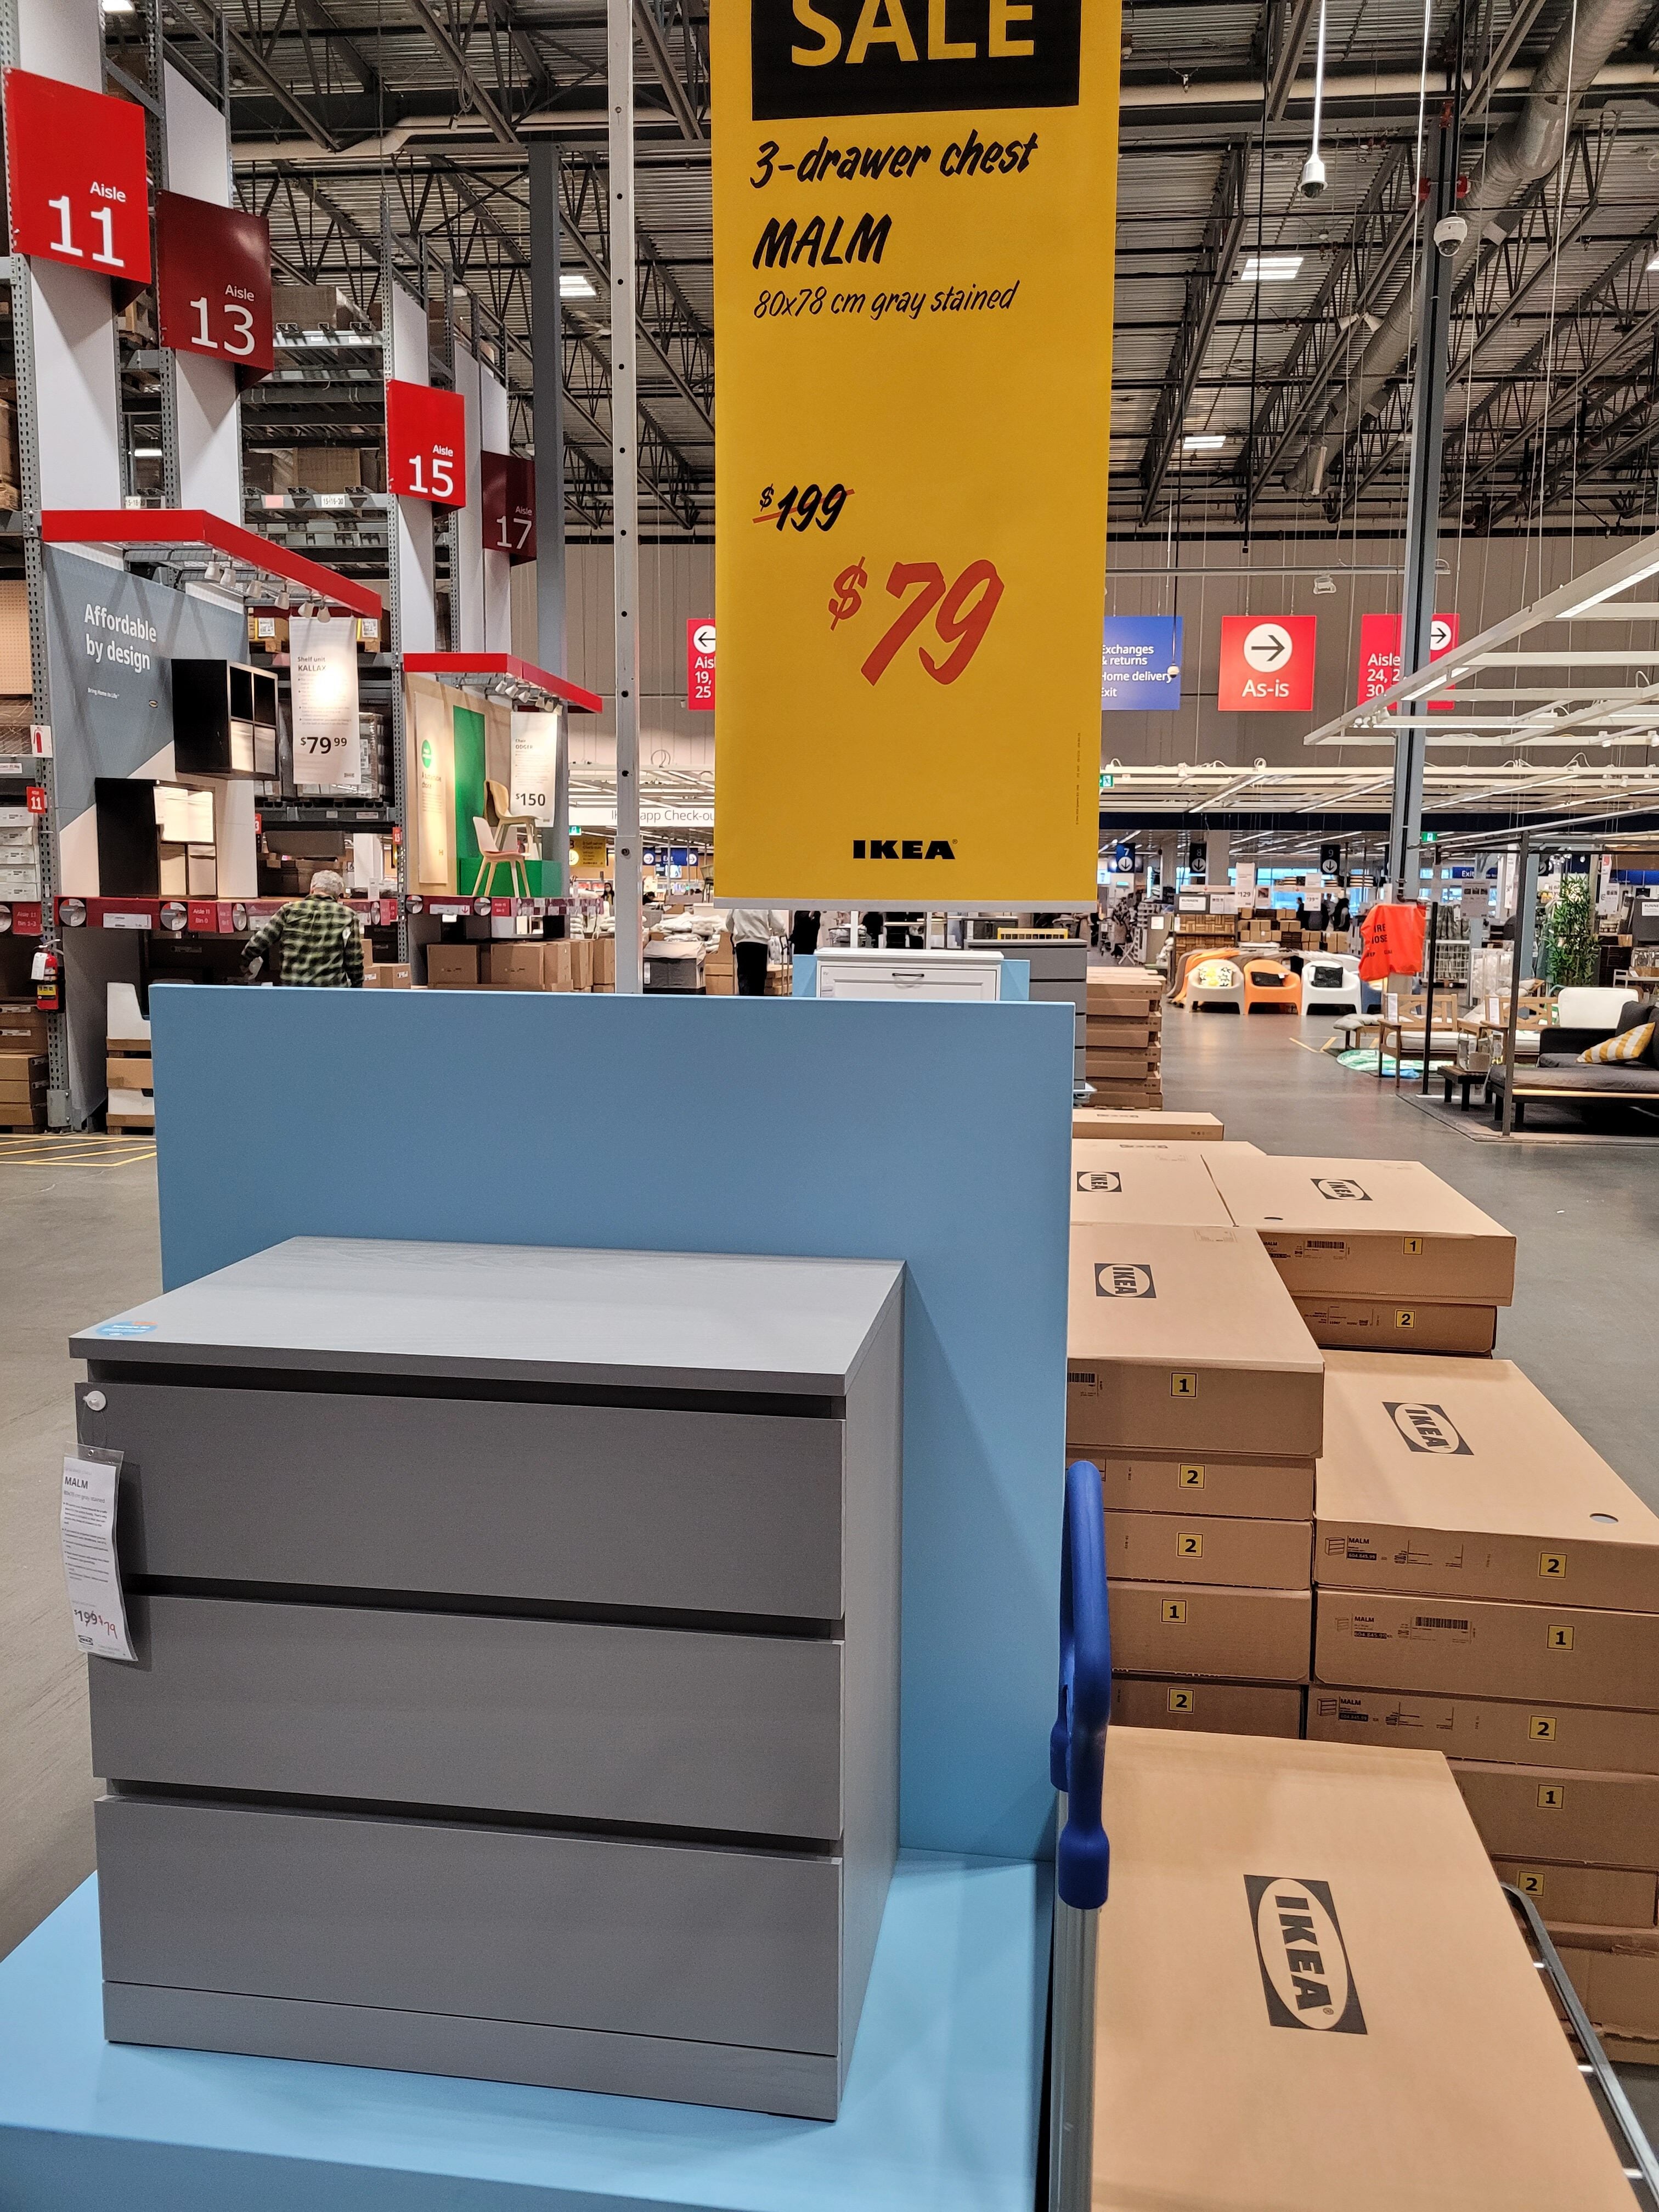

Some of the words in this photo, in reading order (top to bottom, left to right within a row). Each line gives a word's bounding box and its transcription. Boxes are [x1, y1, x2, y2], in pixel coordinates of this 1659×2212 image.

[792, 0, 1034, 66] SALE
[749, 136, 932, 189] 3-drawer
[939, 128, 1039, 177] chest
[90, 181, 126, 202] Aisle
[48, 196, 124, 267] 11
[752, 212, 893, 269] MALM
[225, 284, 255, 302] Aisle
[754, 286, 827, 318] 80x78
[831, 290, 866, 314] cm
[871, 290, 927, 320] gray
[930, 279, 1020, 313] stained
[190, 296, 255, 355] 13
[432, 444, 453, 456] Aisle
[408, 455, 454, 497] 15
[515, 505, 532, 516] Aisle
[496, 516, 532, 549] 17
[84, 603, 157, 643] Affordable
[828, 556, 1005, 686] $79
[86, 633, 103, 663] by
[107, 640, 150, 673] design
[1110, 656, 1148, 665] returns
[695, 670, 712, 685] 19,
[1132, 671, 1172, 683] delivery
[1367, 669, 1387, 684] 24,
[1392, 669, 1400, 682] 2
[695, 686, 712, 698] 25
[1242, 680, 1289, 698] As-is
[301, 737, 331, 754] $79
[31, 797, 42, 810] 11
[515, 793, 545, 806] $150
[640, 811, 661, 823] app
[664, 810, 714, 821] Check-ou
[853, 839, 956, 860] IKEA
[1124, 848, 1129, 856] 7
[1374, 924, 1386, 933] IRE
[1091, 1174, 1108, 1190] IKEA
[1326, 1181, 1356, 1198] IKEA
[1409, 1240, 1416, 1252] 1
[1113, 1267, 1137, 1295] IKEA
[1401, 1314, 1411, 1325] 2
[1179, 1378, 1190, 1393] 1
[1404, 1409, 1450, 1448] IKEA
[65, 1476, 88, 1489] MALM
[1186, 1470, 1199, 1484] 2
[1184, 1538, 1197, 1553] 2
[1547, 1559, 1560, 1573] 2
[1169, 1605, 1180, 1619] 1
[1555, 1631, 1567, 1645] 1
[1176, 1694, 1188, 1707] 2
[1537, 1722, 1549, 1736] 2
[1545, 1790, 1557, 1804] 1
[1525, 1877, 1538, 1892] 2
[1274, 1894, 1332, 2011] IKEA
